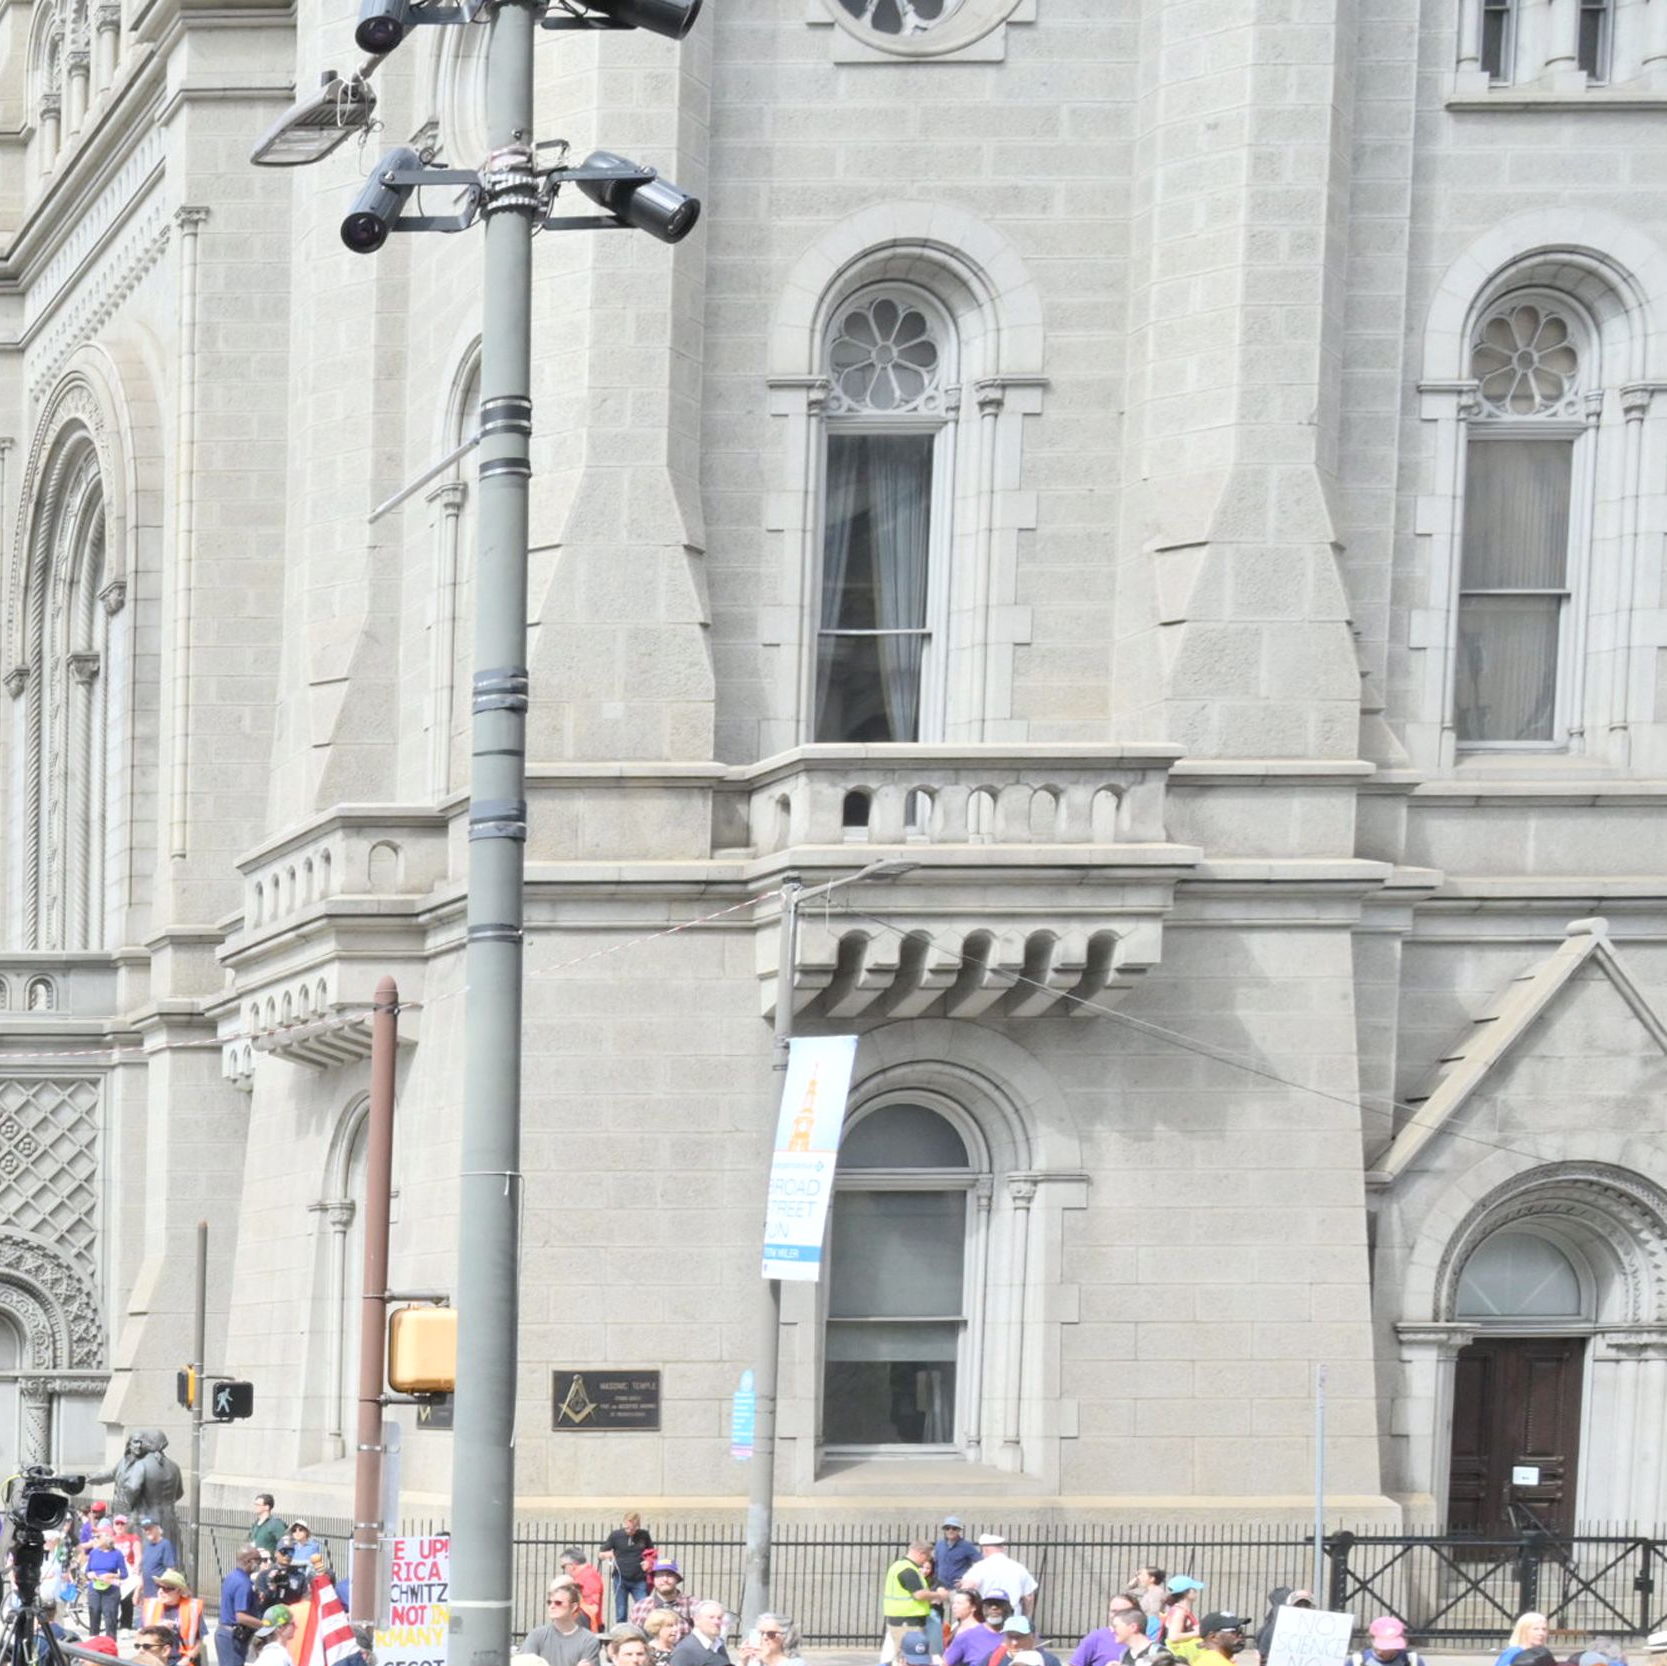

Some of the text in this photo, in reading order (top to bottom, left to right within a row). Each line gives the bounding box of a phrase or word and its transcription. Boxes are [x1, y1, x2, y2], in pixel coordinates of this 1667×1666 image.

[768, 1200, 817, 1217] TREET
[391, 1561, 442, 1581] RICA
[390, 1583, 448, 1603] CHWITZ
[391, 1604, 427, 1626] NOT
